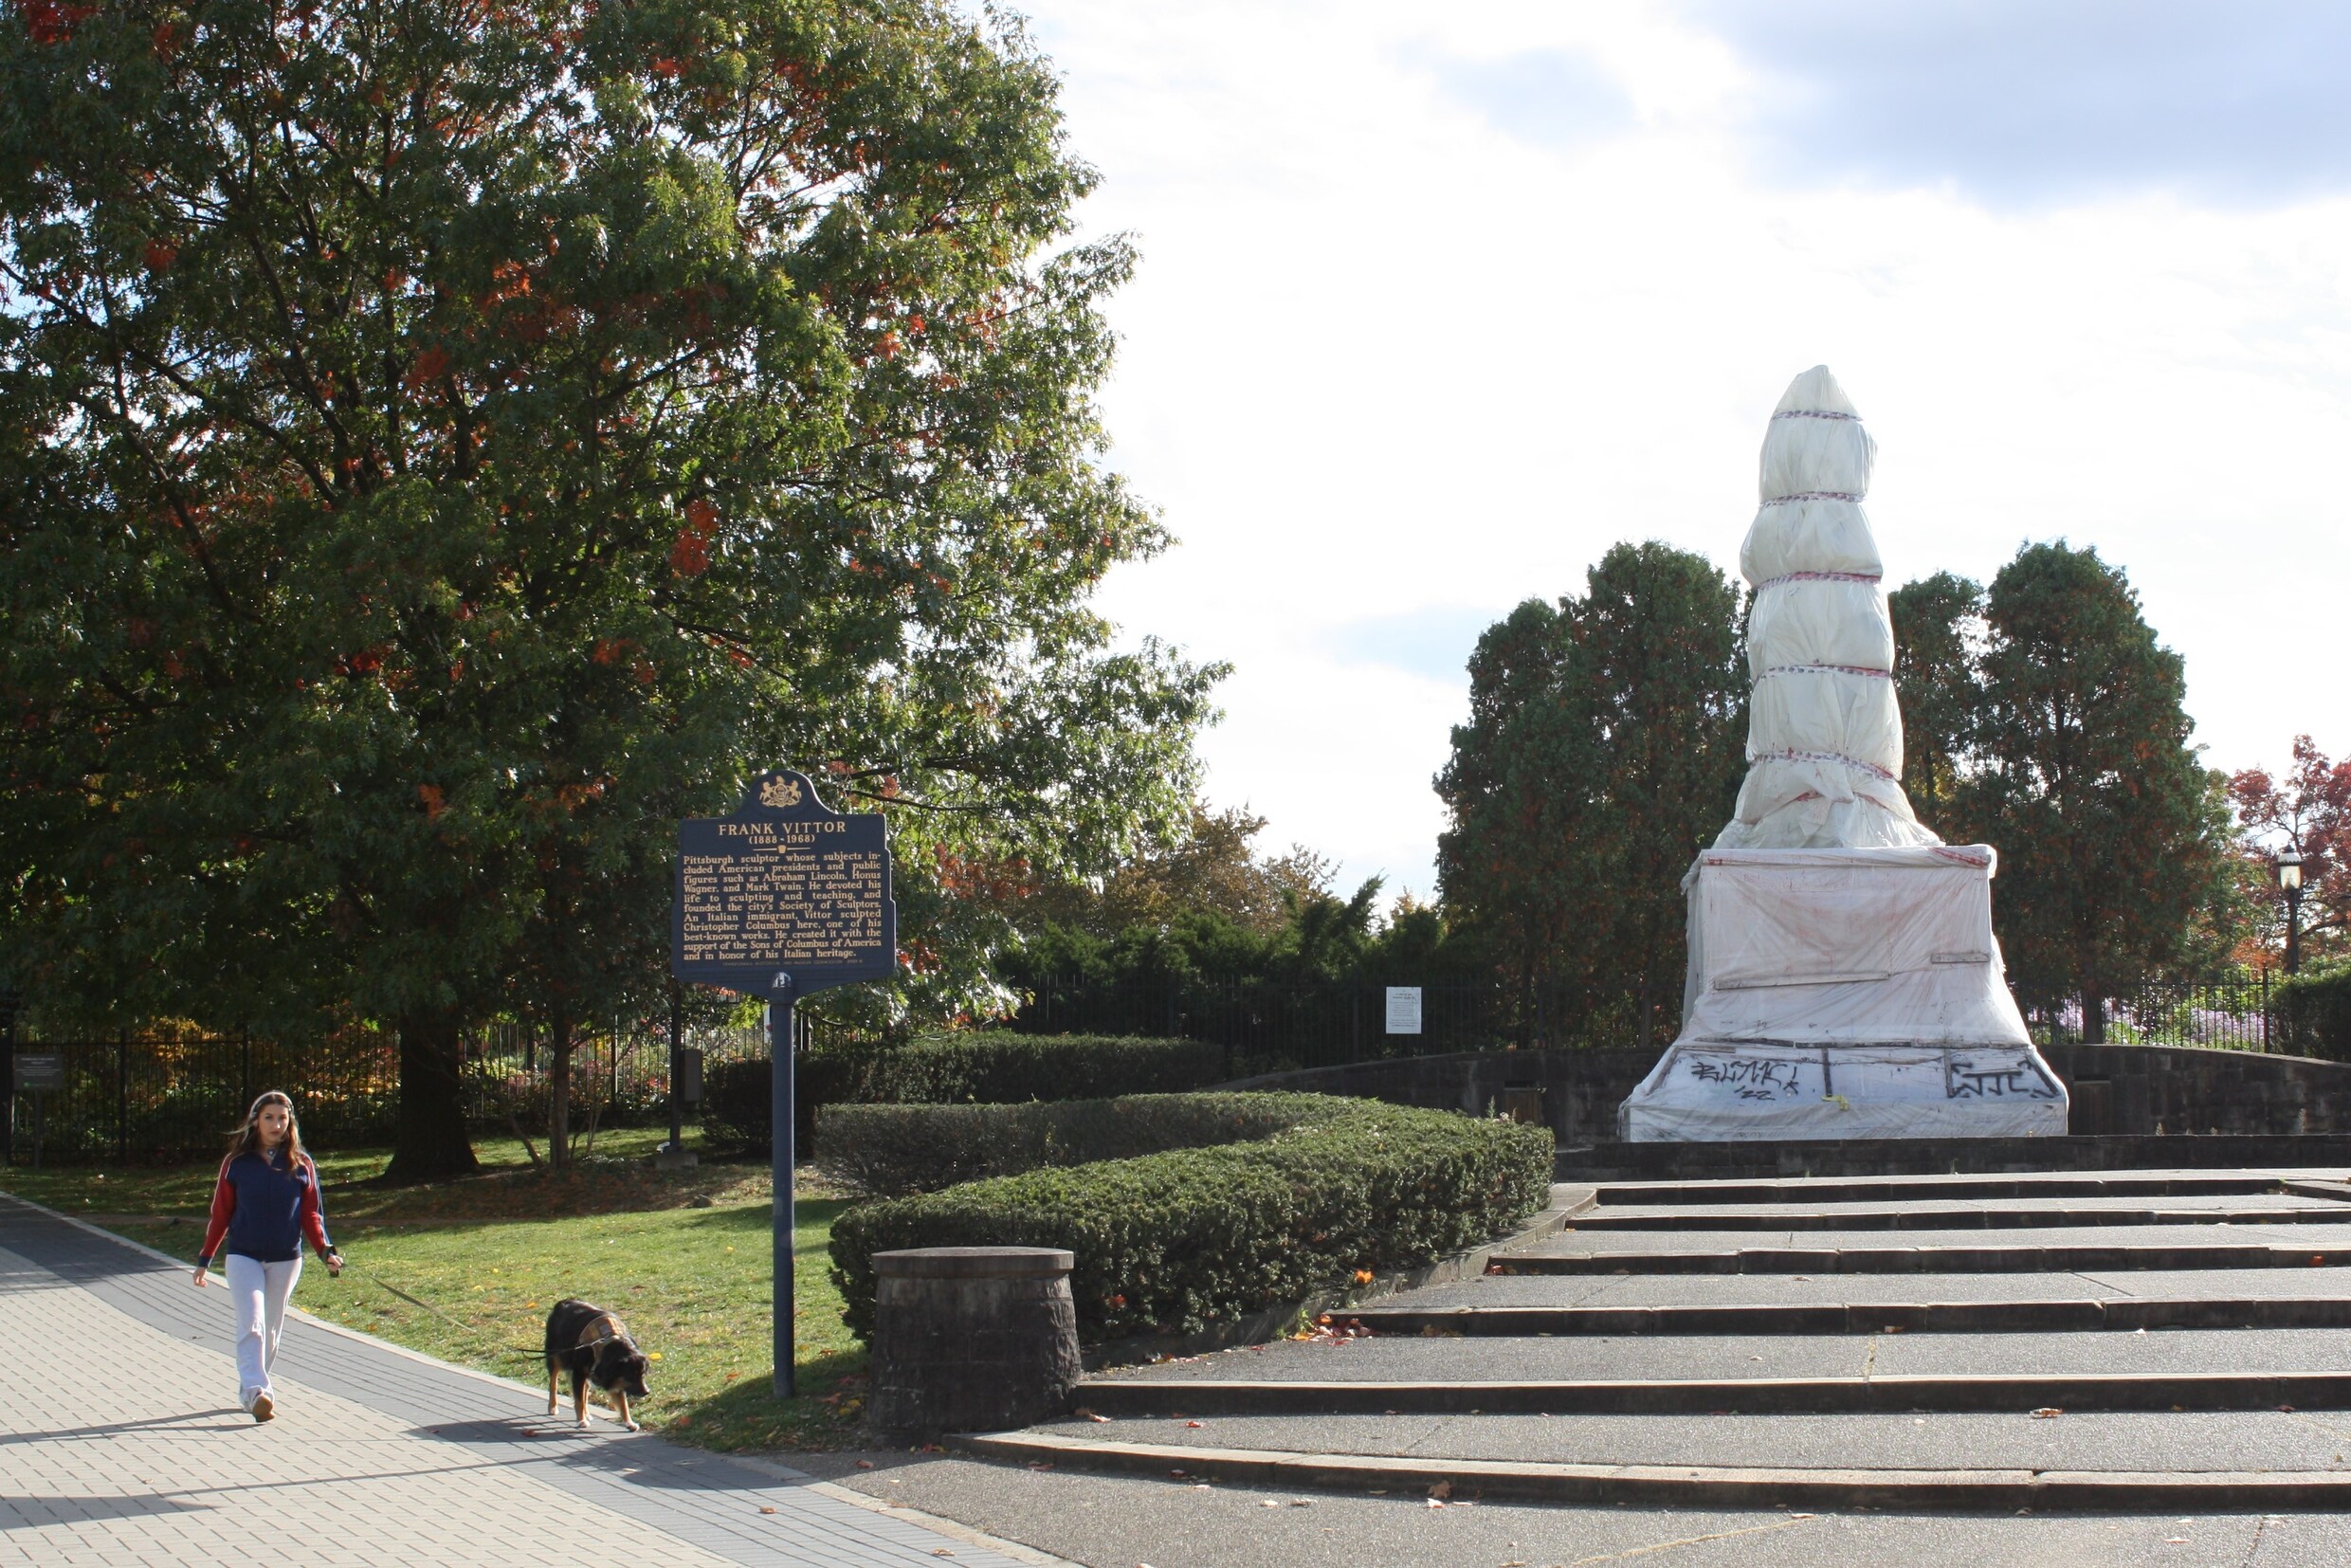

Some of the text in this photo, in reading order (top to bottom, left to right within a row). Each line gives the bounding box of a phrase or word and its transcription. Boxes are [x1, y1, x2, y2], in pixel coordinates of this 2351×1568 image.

[719, 821, 846, 835] FRANK VITTOR
[683, 851, 881, 866] Pittsburgh sculptor whose subjects in-
[683, 861, 882, 874] cluded American presidents and public
[683, 875, 718, 885] figures
[723, 873, 744, 883] such
[762, 872, 806, 882] Abraham
[852, 871, 882, 880] Honus
[723, 884, 740, 892] and
[746, 883, 770, 891] Mark
[774, 882, 805, 891] Twain.
[809, 882, 822, 890] He
[826, 881, 863, 889] devoted
[868, 880, 882, 888] his
[683, 894, 702, 903] life
[729, 892, 774, 903] sculpting
[784, 892, 802, 901] and
[864, 889, 882, 899] and
[683, 900, 882, 913] founded the city's Society of Sculptors.
[683, 913, 699, 922] An
[707, 912, 738, 921] Italian
[805, 910, 832, 919] Vittor
[840, 909, 882, 920] sculpted
[683, 922, 739, 933] Christopher
[745, 921, 790, 930] Columbus
[850, 919, 862, 927] of
[867, 919, 882, 927] his
[683, 928, 882, 941] best-known works. He created it with the
[683, 938, 882, 953] support of the Sons of Columbus of America
[683, 948, 857, 960] and in honor of his Italian heritage.
